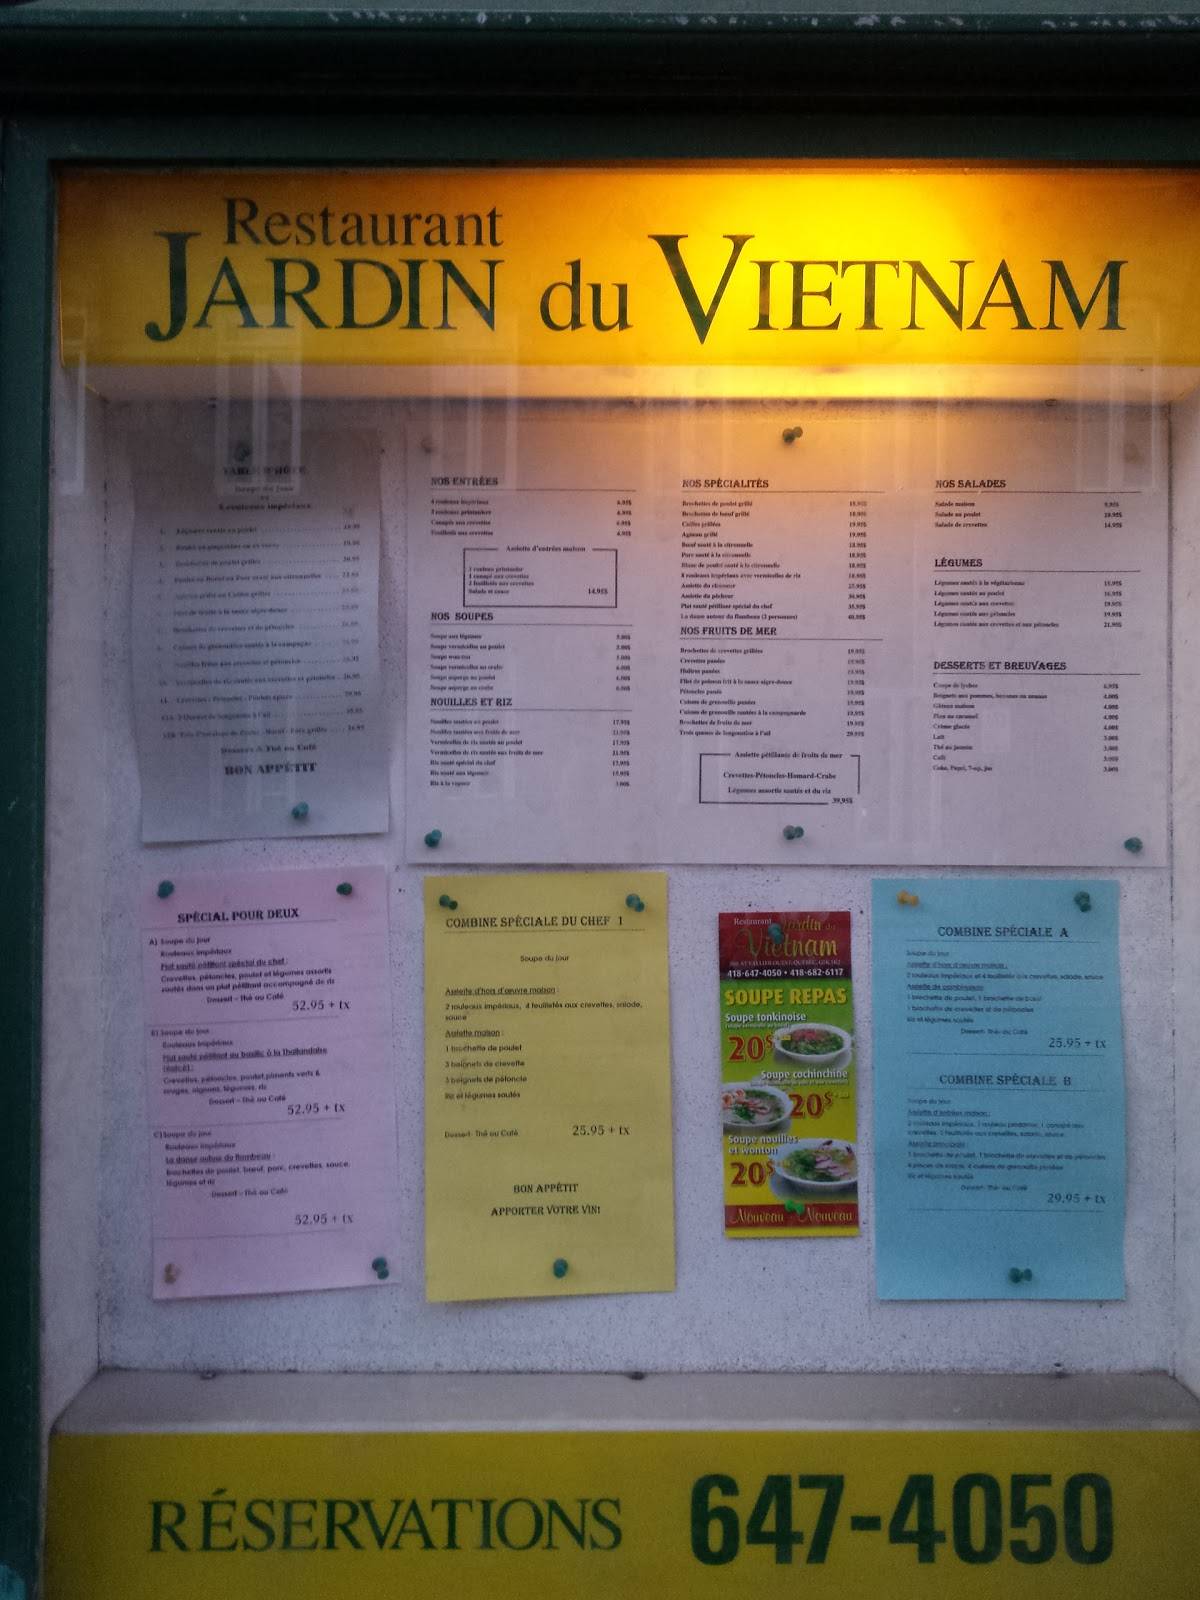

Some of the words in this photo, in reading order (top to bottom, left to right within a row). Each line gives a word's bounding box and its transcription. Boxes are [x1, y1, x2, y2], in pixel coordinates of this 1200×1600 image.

[223, 196, 505, 248] Restaurant
[144, 231, 506, 343] JARDIN
[539, 260, 630, 332] du
[647, 233, 1129, 346] VIETNAM
[430, 477, 450, 486] NOS
[452, 475, 499, 486] ENTRÉES
[682, 479, 702, 488] NOS
[704, 477, 770, 488] SPÉCIALITÉS
[935, 480, 956, 488] NOS
[957, 480, 1007, 489] SALADES
[934, 557, 983, 568] LÉGUMES
[430, 612, 450, 621] NOS
[454, 611, 494, 621] SOUPES
[680, 627, 700, 636] NOS
[702, 627, 737, 636] FRUITS
[740, 627, 753, 636] DE
[755, 627, 777, 636] MER
[933, 661, 986, 671] DESSERTS
[988, 661, 1002, 670] ET
[1004, 660, 1067, 671] BREUVAGES
[430, 697, 478, 707] NOUILLES
[480, 697, 493, 706] ET
[495, 697, 513, 706] RIZ
[224, 764, 253, 776] BON
[177, 909, 229, 924] SPÉCIAL
[232, 910, 264, 921] POUR
[267, 907, 300, 919] DEUX
[445, 917, 497, 929] COMBINE
[499, 914, 558, 928] SPÉCIALE
[562, 916, 577, 926] DU
[580, 915, 611, 926] CHEF
[617, 916, 623, 926] 1
[937, 926, 991, 937] COMBINE
[994, 924, 1053, 938] SPÉCIALE
[1059, 927, 1069, 938] A
[735, 927, 838, 960] Vietnam
[520, 954, 543, 963] Soupe
[545, 954, 554, 962] du
[555, 954, 570, 963] jour
[727, 968, 782, 978] 418-647-4050
[789, 967, 844, 977] 418-682-6117
[724, 988, 785, 1006] SOUPE
[789, 987, 848, 1005] REPAS
[292, 1000, 325, 1011] 52.95
[328, 1001, 336, 1009] +
[338, 999, 351, 1011] tx
[725, 1012, 755, 1023] Soupe
[757, 1012, 807, 1021] tonkinoise
[487, 1044, 497, 1053] de
[499, 1044, 523, 1053] poulet
[1048, 1037, 1081, 1049] 25.95
[1095, 1038, 1107, 1049] tx
[760, 1070, 790, 1080] Soupe
[792, 1069, 848, 1079] cochinchine
[939, 1074, 994, 1086] COMBINE
[996, 1072, 1056, 1086] SPÉCIALE
[1063, 1075, 1072, 1086] B
[287, 1103, 320, 1116] 52.95
[334, 1103, 346, 1114] tx
[500, 1129, 519, 1137] Café
[571, 1125, 606, 1137] 25.95
[618, 1125, 631, 1136] tx
[728, 1135, 757, 1146] Soupe
[760, 1134, 799, 1145] nouilles
[742, 1147, 779, 1155] wonton
[513, 1184, 534, 1194] BON
[536, 1182, 579, 1193] APPÉTIT
[1047, 1192, 1081, 1204] 29.95
[1094, 1194, 1106, 1204] tx
[490, 1206, 544, 1217] APPORTER
[546, 1205, 579, 1216] VOTRE
[294, 1214, 328, 1225] 52.95
[342, 1213, 354, 1224] tx
[147, 1488, 624, 1554] RÉSERVATIONS
[690, 1471, 1115, 1567] 647-4050
